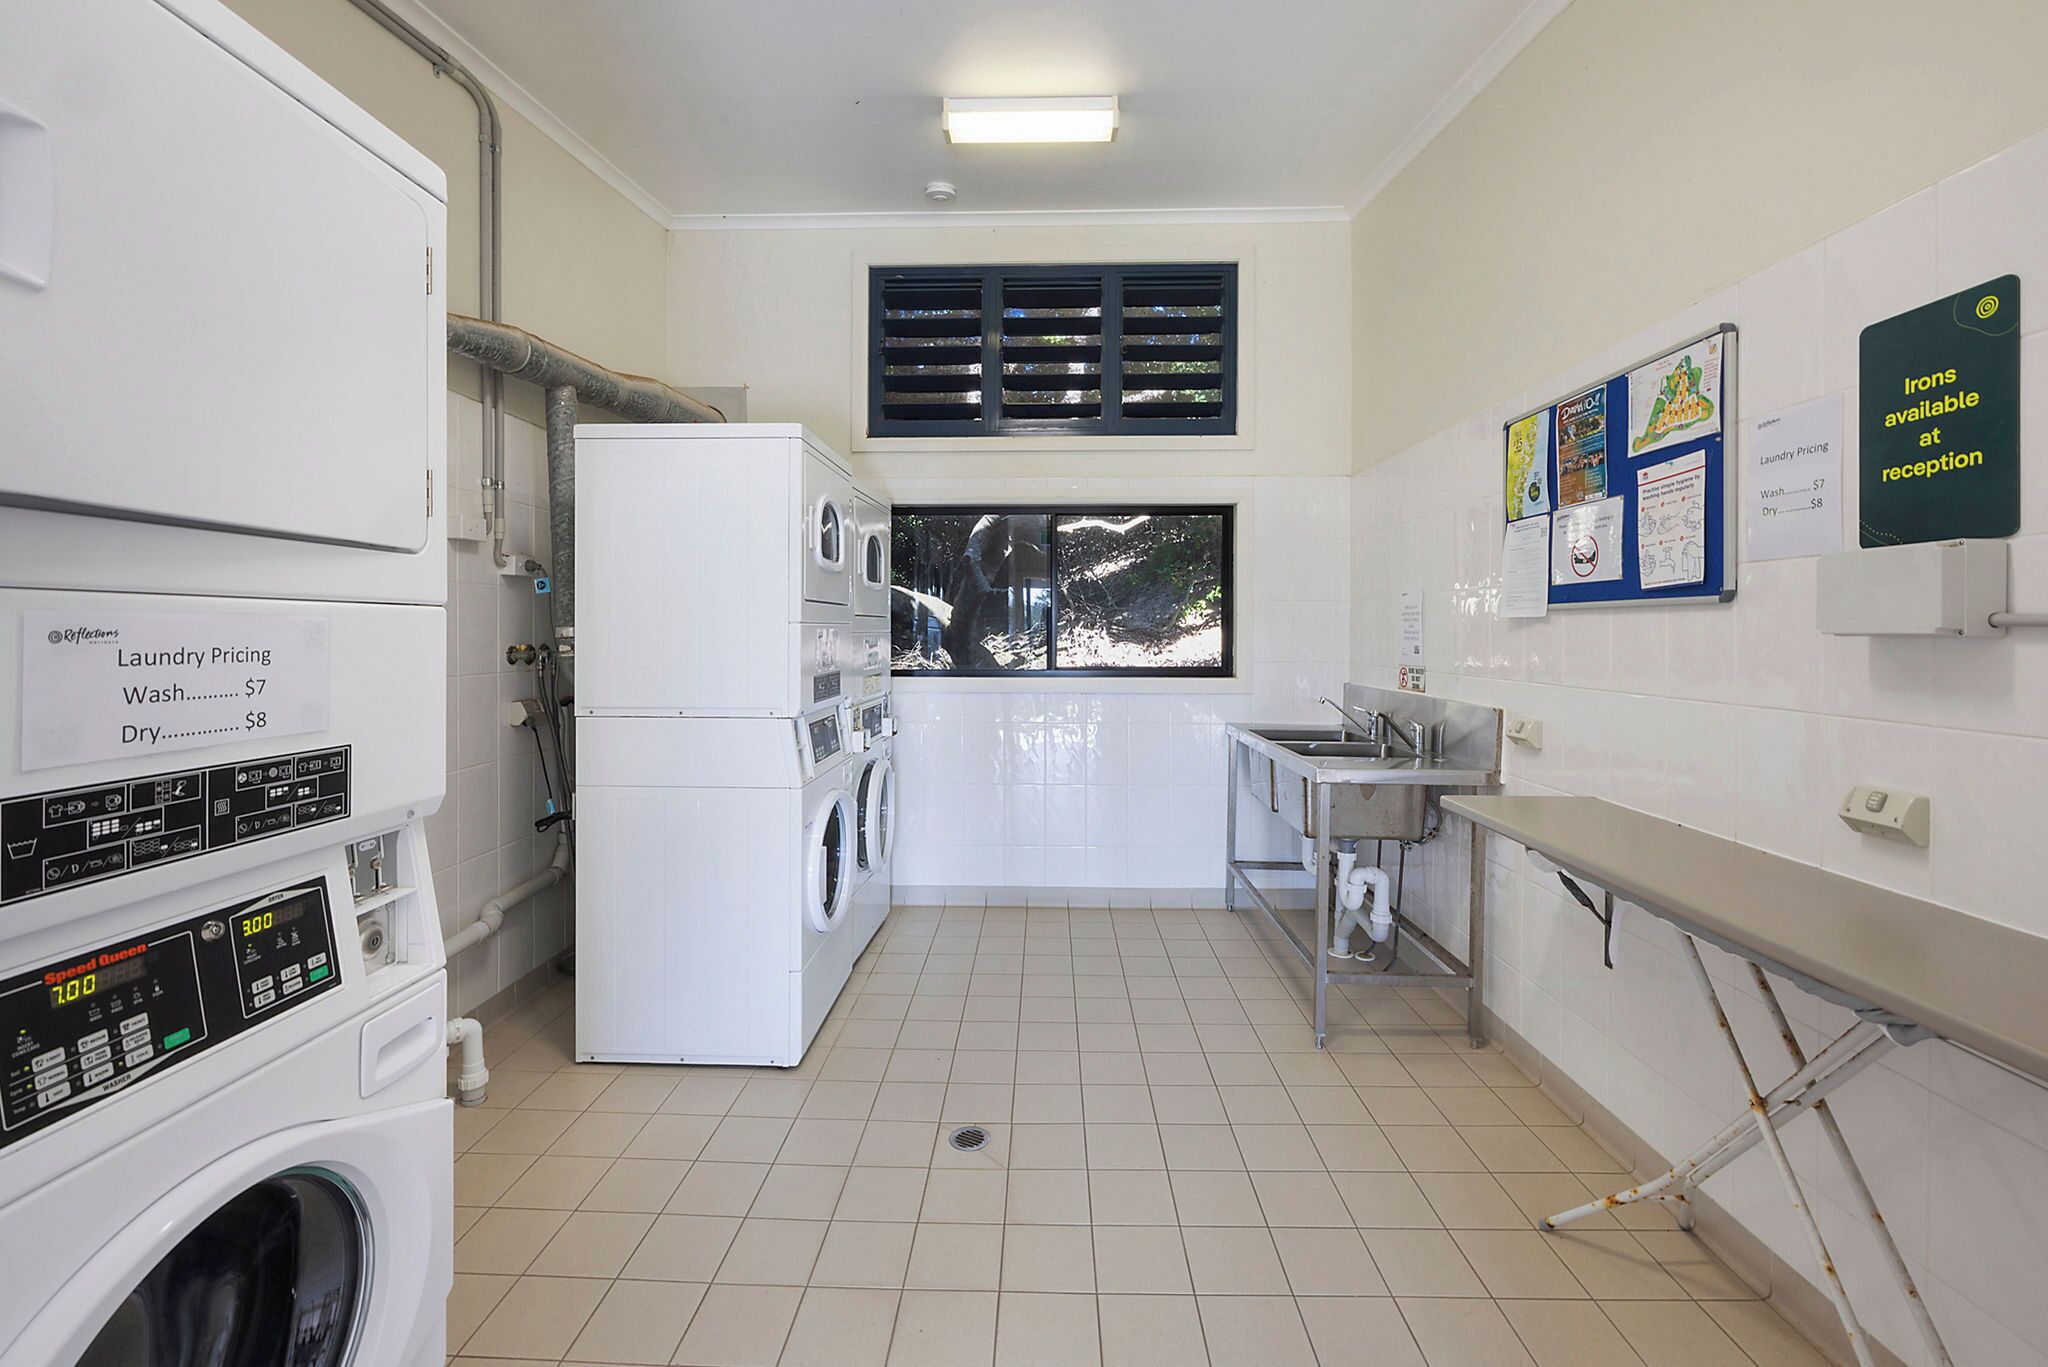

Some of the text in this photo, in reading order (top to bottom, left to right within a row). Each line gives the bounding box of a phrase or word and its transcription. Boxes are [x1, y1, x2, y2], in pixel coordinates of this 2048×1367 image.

[1904, 368, 1957, 395] Irons
[1884, 390, 1980, 428] available
[1919, 427, 1941, 447] at
[1760, 442, 1829, 466] Laundry Pricing
[1882, 450, 1983, 482] reception
[1813, 478, 1825, 490] $7
[1810, 498, 1823, 509] $8
[64, 626, 119, 645] Reflections
[118, 646, 272, 669] Laundry Pricing
[245, 677, 266, 698] $7
[245, 710, 267, 732] $8
[268, 893, 284, 903] DRYER
[242, 912, 273, 937] 3.00
[44, 942, 148, 986] Speed Queen
[52, 974, 96, 1005] 7.00
[102, 1074, 132, 1092] WASHER
